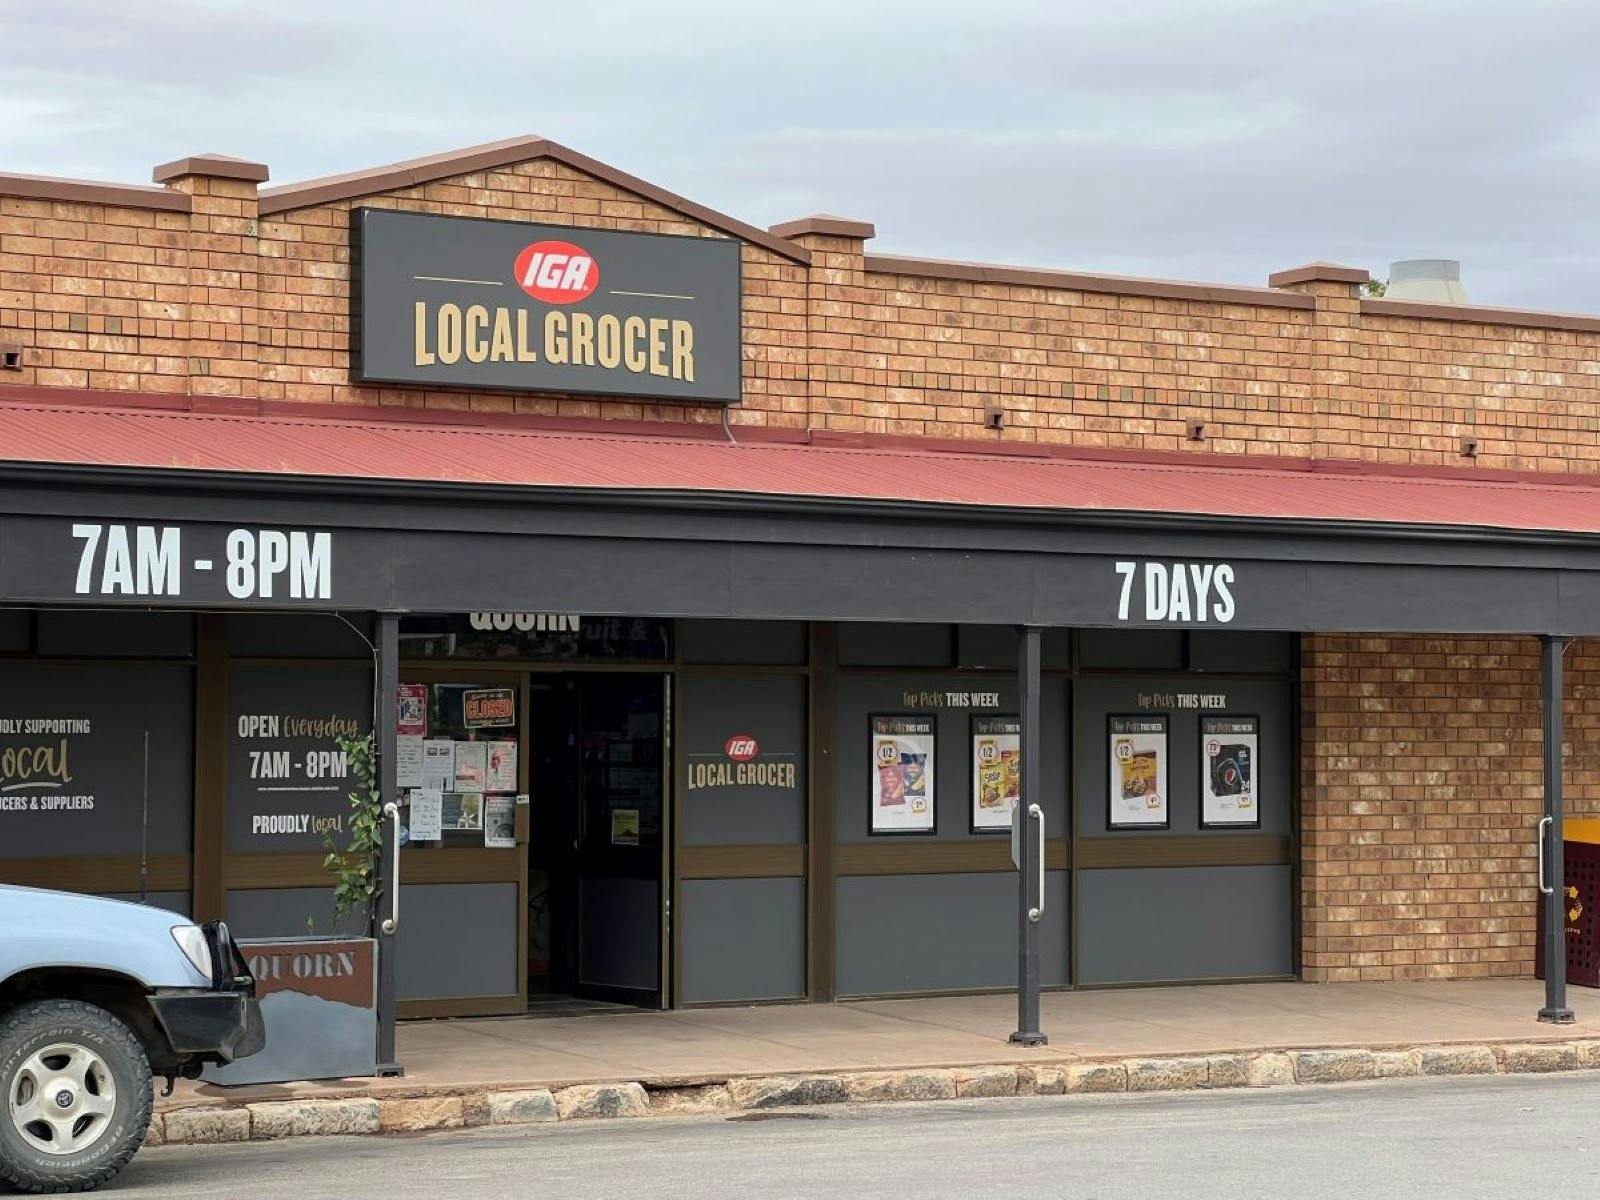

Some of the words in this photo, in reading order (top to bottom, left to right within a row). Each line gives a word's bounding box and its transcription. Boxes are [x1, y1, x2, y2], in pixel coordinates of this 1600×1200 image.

[522, 252, 592, 291] IGA
[414, 301, 537, 367] LOCAL
[543, 309, 695, 382] GROCER
[71, 523, 181, 596] 7AM
[193, 559, 213, 570] -
[225, 528, 332, 600] 8PM
[1115, 561, 1137, 621] 7
[1144, 562, 1236, 623] DAYS
[945, 692, 970, 707] THIS
[970, 692, 1000, 707] WEEK
[1176, 693, 1199, 708] THIS
[1199, 694, 1226, 709] WEEK
[0, 719, 23, 734] DLY
[24, 719, 91, 734] SUPPORTING
[237, 715, 280, 738] OPEN
[283, 713, 358, 739] Everyday
[0, 738, 73, 783] ocal
[728, 740, 756, 755] IGA
[249, 751, 290, 778] 7AM
[305, 751, 347, 778] 8PM
[687, 763, 735, 790] LOCAL
[736, 763, 796, 789] GROCER
[0, 796, 28, 811] CERS
[29, 796, 39, 810] &
[40, 796, 95, 810] SUPPLIERS
[252, 813, 310, 834] PROUDLY
[311, 814, 343, 834] local
[248, 951, 356, 981] QUORN
